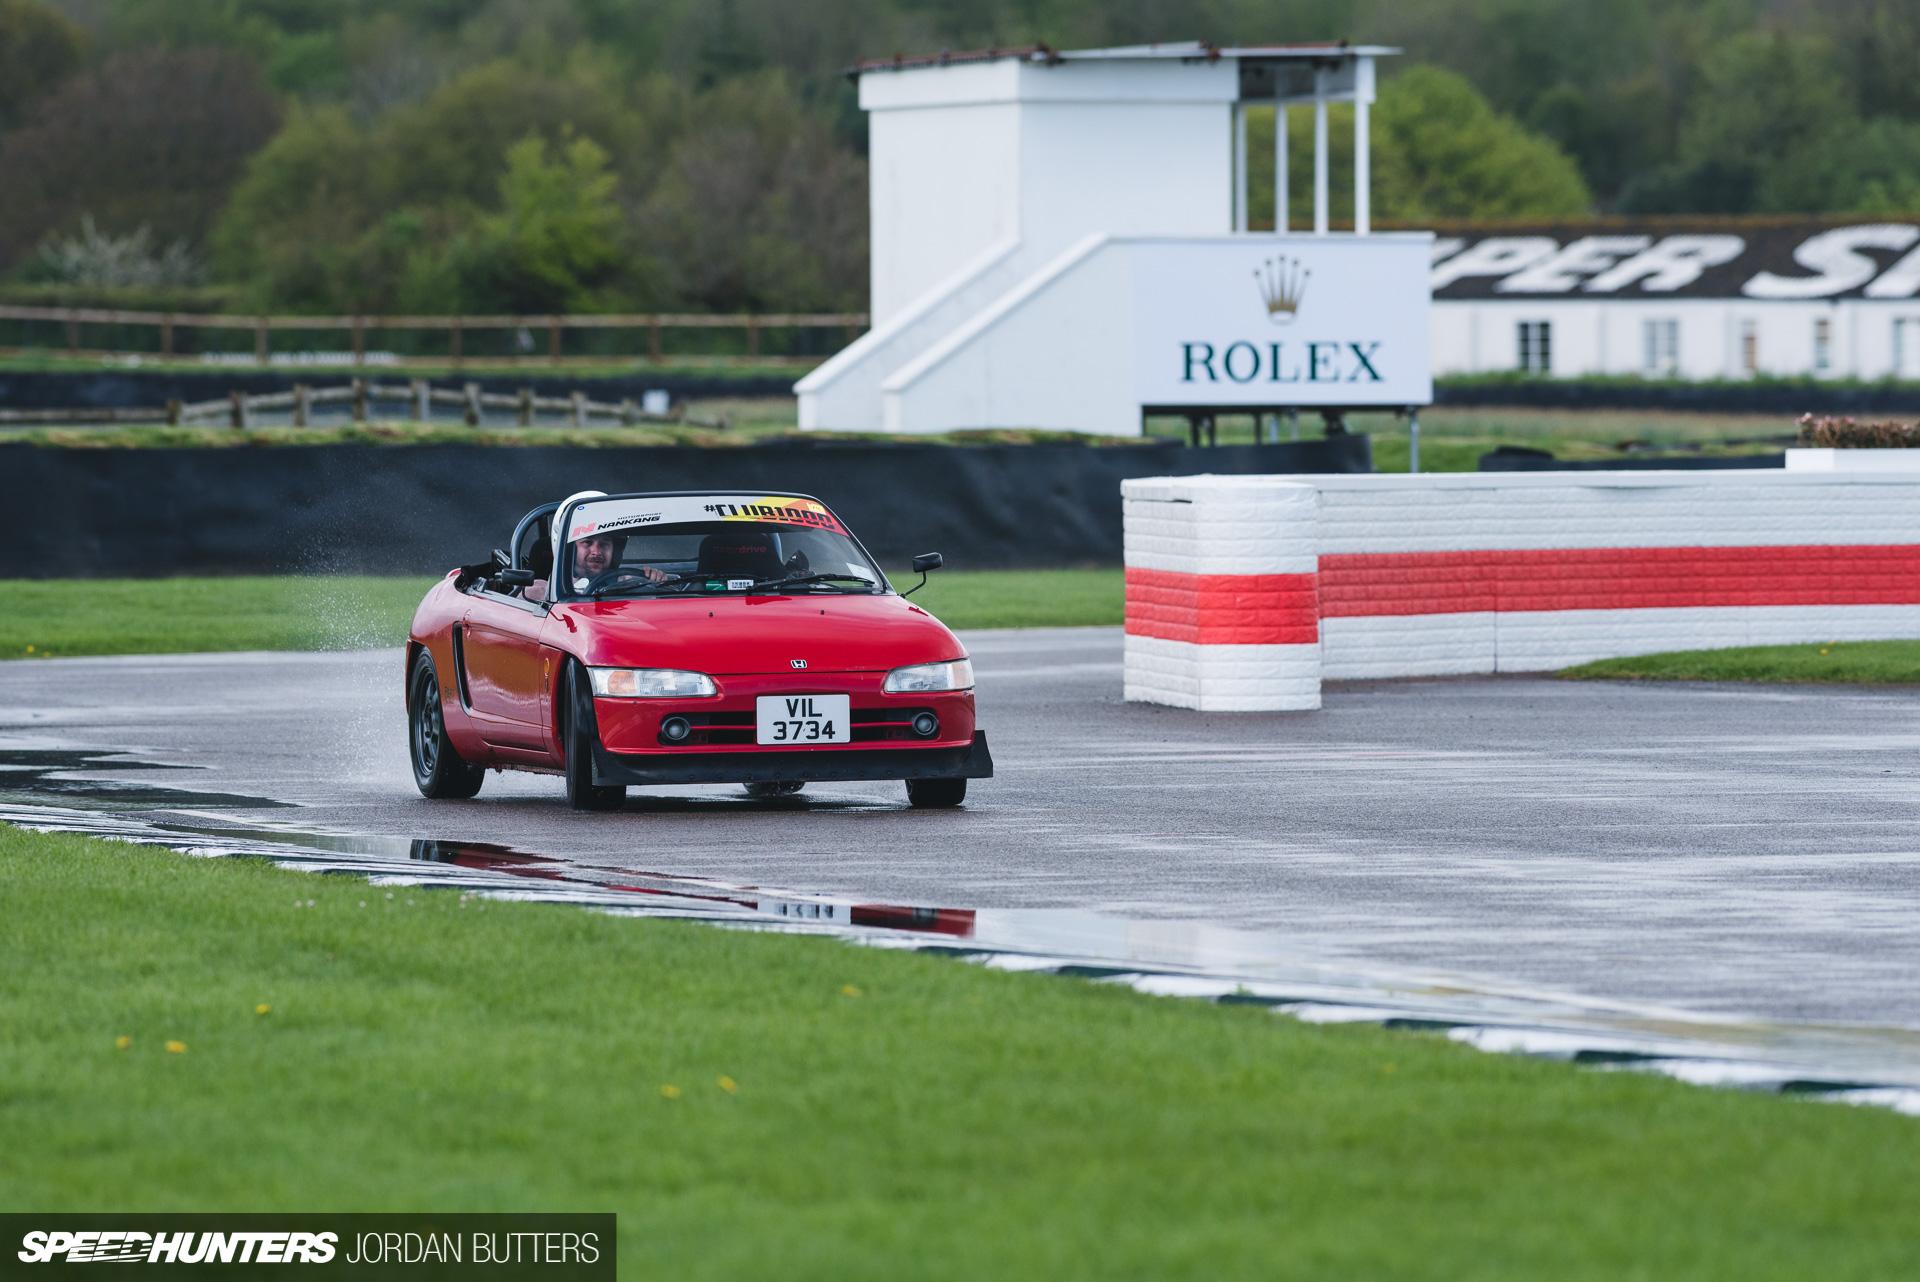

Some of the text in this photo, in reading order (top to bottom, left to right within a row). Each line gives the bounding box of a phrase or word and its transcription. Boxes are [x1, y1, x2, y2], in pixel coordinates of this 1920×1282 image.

[1179, 340, 1385, 384] ROLEX
[597, 515, 661, 530] NANKANG
[713, 545, 767, 554] motordrive
[785, 698, 823, 718] VIL
[772, 720, 836, 741] 3734
